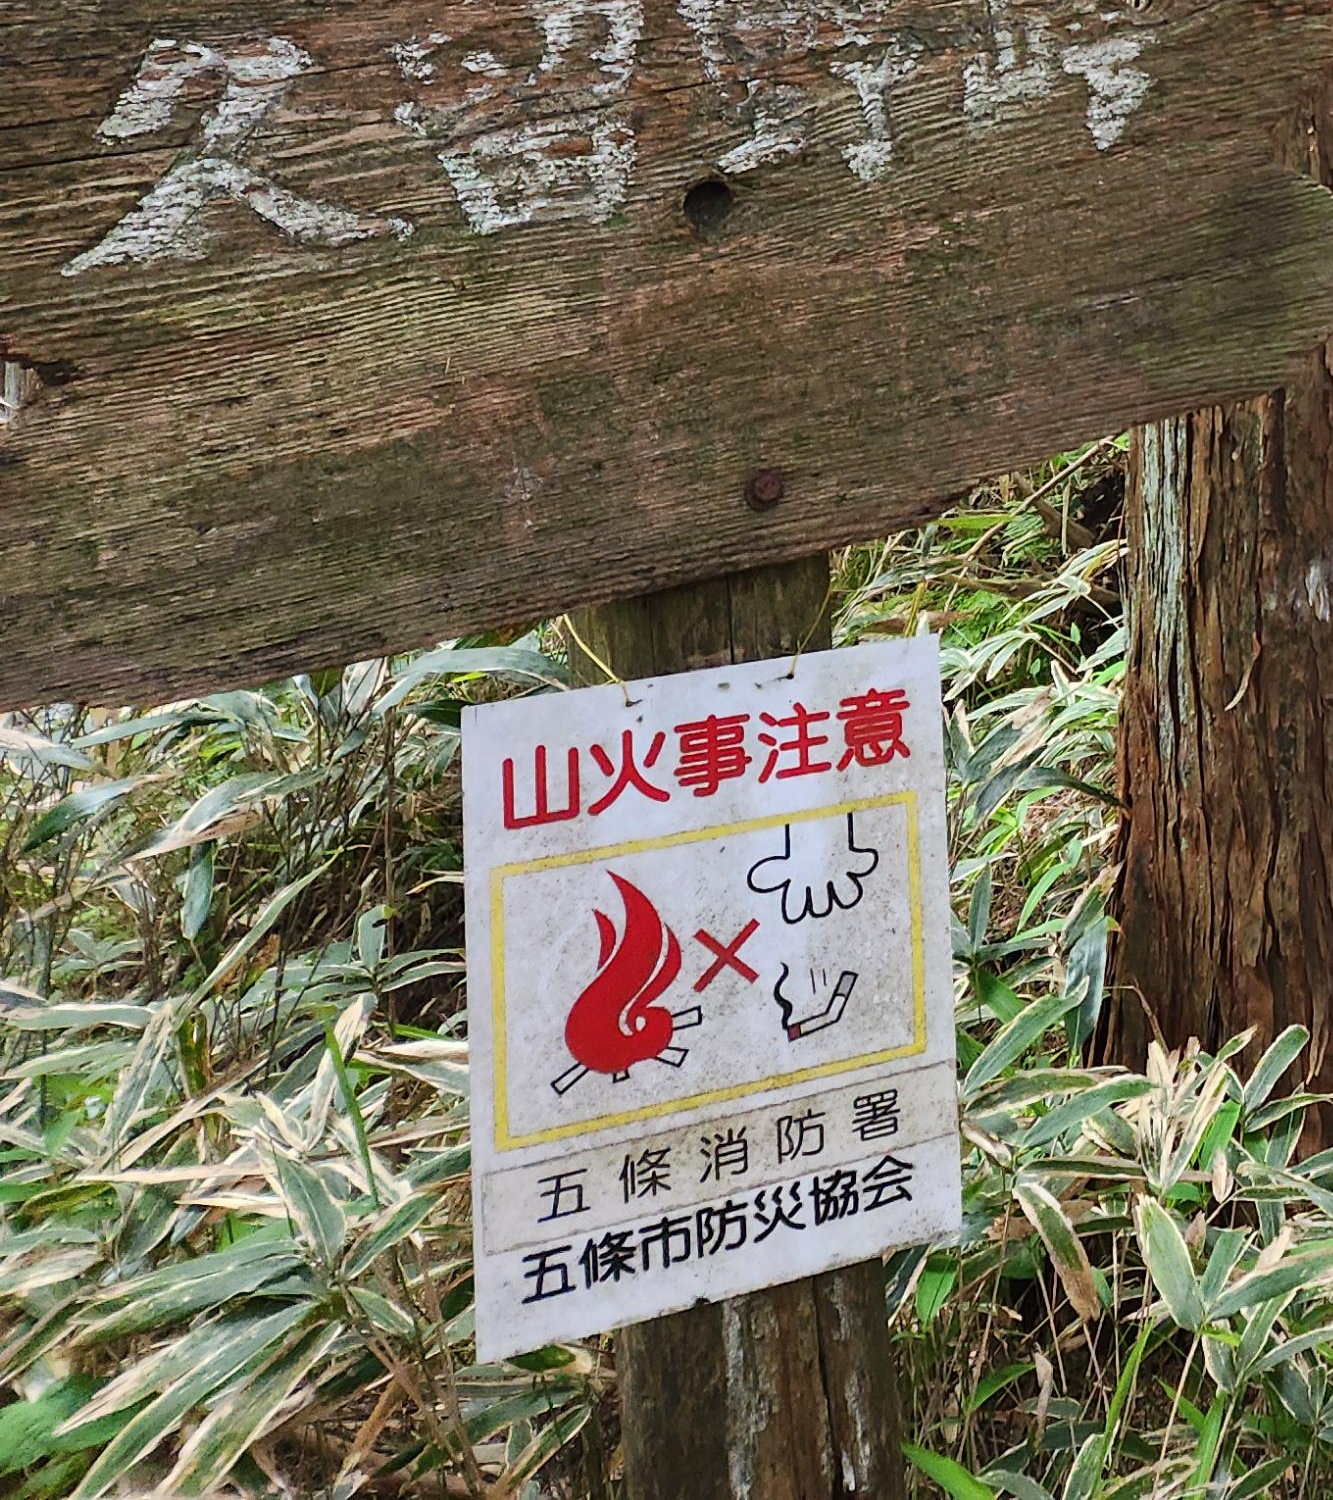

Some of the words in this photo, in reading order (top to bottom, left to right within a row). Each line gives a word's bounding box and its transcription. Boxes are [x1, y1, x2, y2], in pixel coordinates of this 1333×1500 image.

[501, 687, 911, 830] 山火事注意
[536, 1088, 902, 1223] 五條消防署
[520, 1154, 915, 1304] 五條市防災協会
